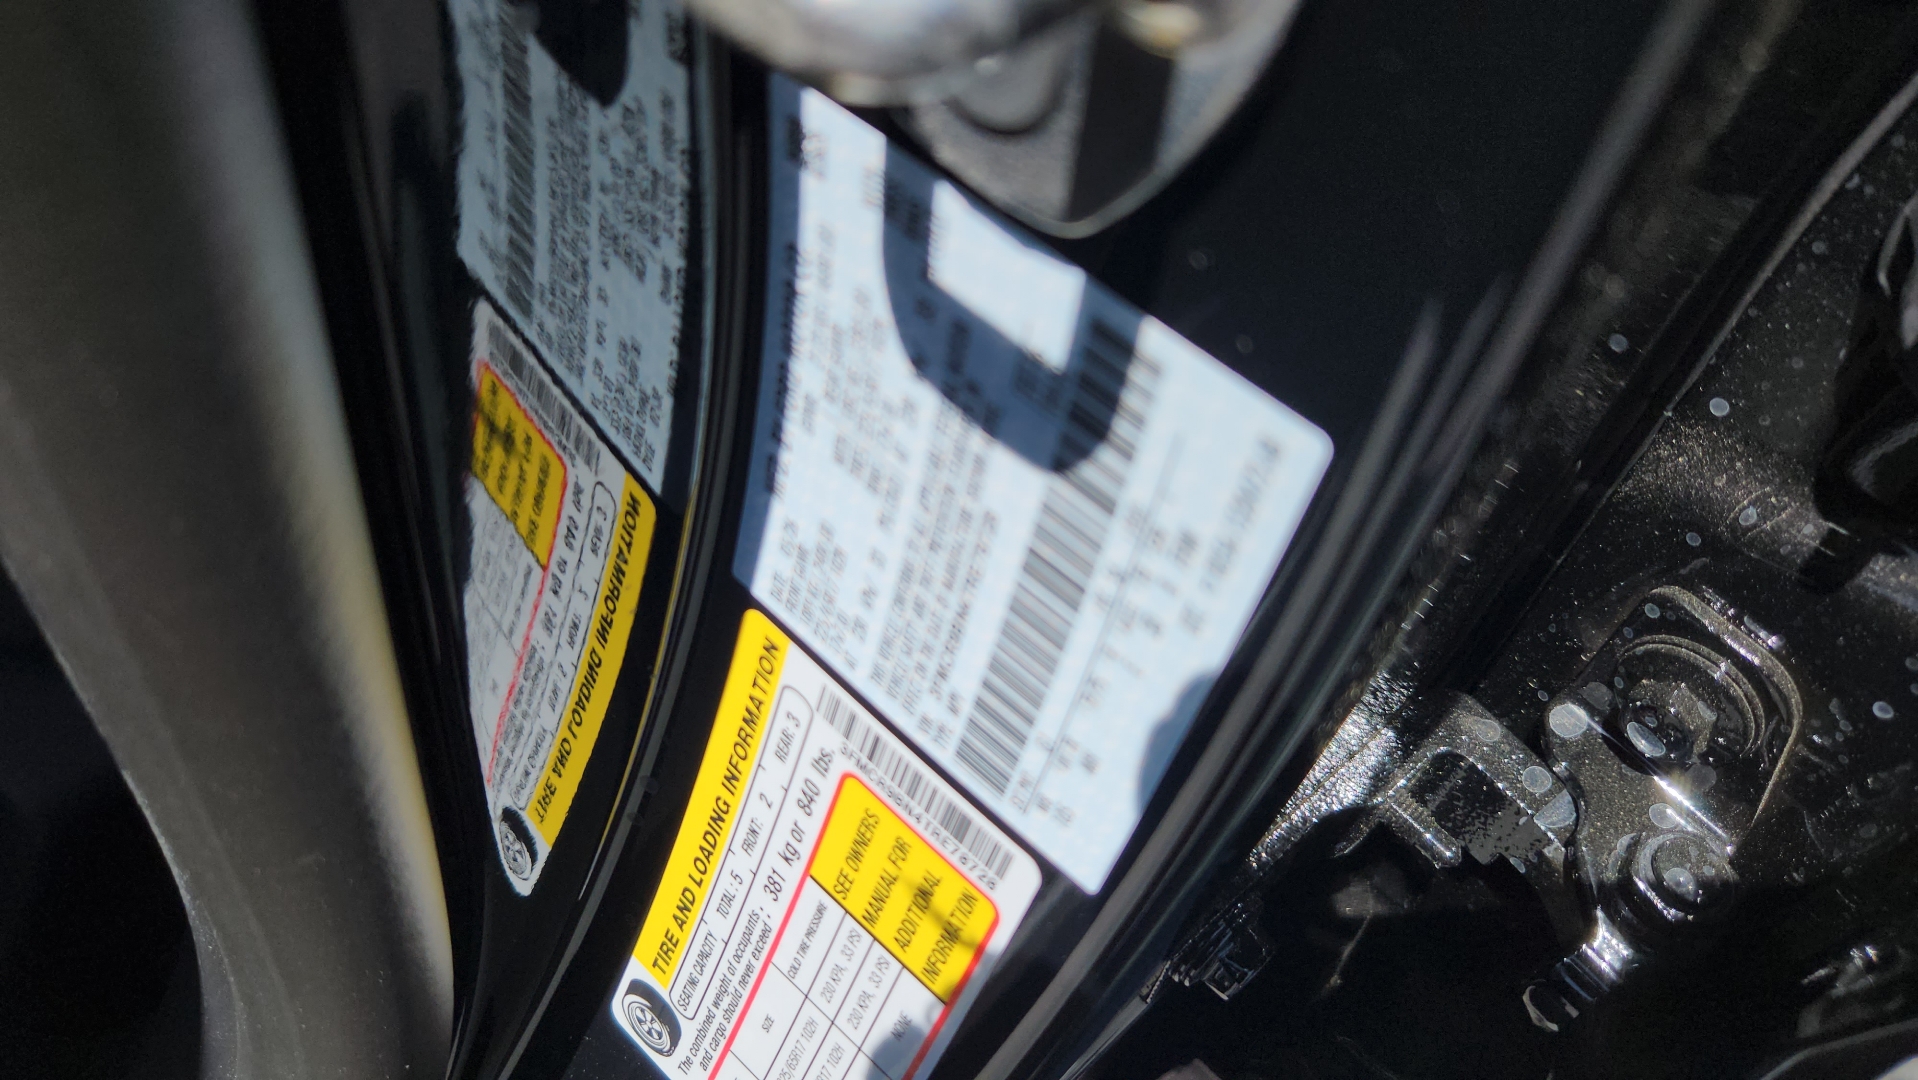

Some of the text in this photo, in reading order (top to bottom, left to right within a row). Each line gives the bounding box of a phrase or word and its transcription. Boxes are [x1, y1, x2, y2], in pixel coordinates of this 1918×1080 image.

[652, 635, 779, 977] TIRE AND LOADING INFORMATION
[762, 739, 836, 903] 381 kg or 840 lbs.
[676, 970, 700, 1013] SEATING
[691, 928, 718, 977] CAPACITY
[730, 869, 743, 885] 5
[740, 815, 764, 857] FRONT:
[758, 791, 773, 809] 2
[774, 724, 795, 763] REAR:
[786, 710, 801, 728] 3
[832, 805, 880, 902] SEE OWNERS
[861, 833, 912, 929] MANUAL FOR
[786, 899, 828, 980] COLD TIRE PRESSURE
[846, 926, 862, 949] PSI
[891, 863, 942, 953] ADDITIONAL
[920, 884, 979, 985] INFORMATION
[840, 942, 854, 963] 33
[867, 968, 882, 989] 33
[874, 952, 891, 977] PSI
[677, 909, 762, 1076] The combined weight of occupants
[698, 921, 772, 1072] and cargo should never exceed
[761, 1013, 774, 1034] SIZE
[819, 979, 836, 1005] 230
[846, 1005, 863, 1031] 230
[890, 1010, 912, 1041] NONE
[776, 1016, 818, 1080] 25/65R17 102H
[826, 1041, 845, 1069] 102H
